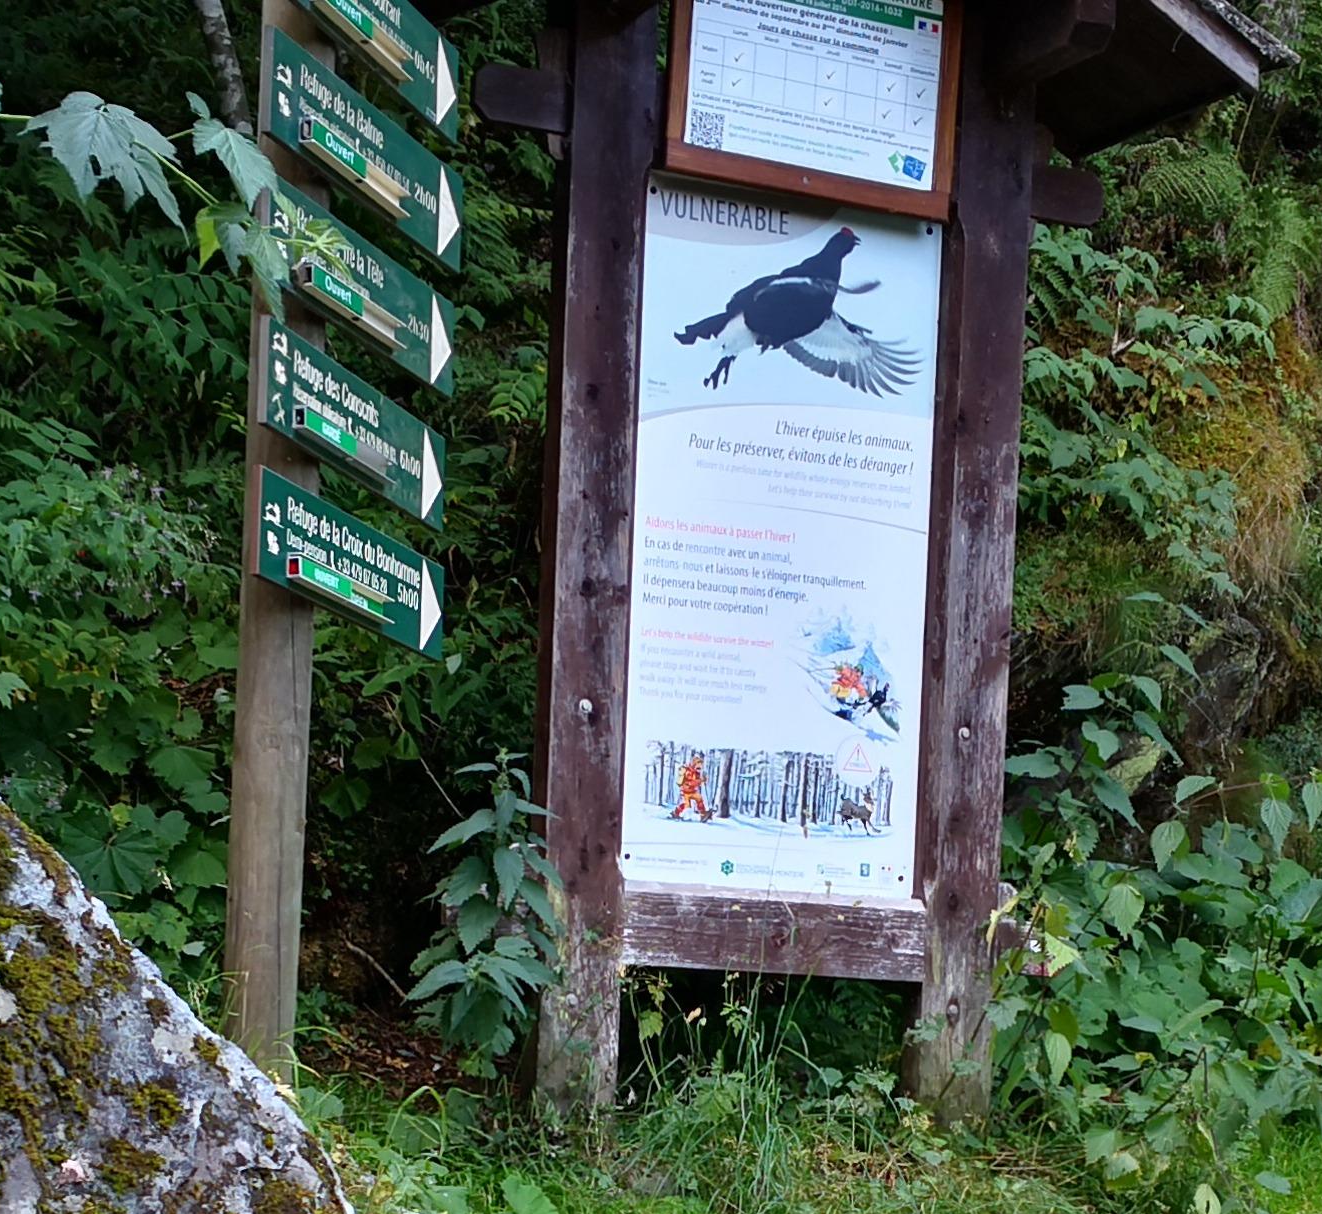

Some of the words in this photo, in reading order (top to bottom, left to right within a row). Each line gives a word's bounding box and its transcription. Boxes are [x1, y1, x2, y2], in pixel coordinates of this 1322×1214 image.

[799, 8, 836, 23] générale
[838, 16, 849, 26] de
[851, 18, 859, 28] la
[860, 21, 888, 34] chasse
[325, 133, 354, 164] Ouvert
[414, 182, 437, 214] 2h00
[660, 190, 790, 235] VULNERABLE
[324, 275, 352, 305] Ouvert
[407, 313, 429, 343] 2h30
[775, 420, 810, 438] L'hiver
[812, 425, 847, 443] épuise
[848, 429, 862, 445] les
[864, 434, 914, 452] animaux.
[399, 449, 421, 479] 6h00
[688, 433, 715, 450] Pour
[716, 436, 732, 452] les
[733, 440, 785, 460] préserver,
[787, 446, 826, 464] évitons
[828, 452, 842, 467] de
[843, 452, 857, 470] les
[860, 455, 908, 478] déranger
[287, 495, 318, 537] Refuge
[319, 516, 331, 541] de
[332, 520, 341, 547] la
[341, 525, 363, 559] Croix
[364, 539, 375, 565] du
[376, 545, 420, 589] Bonhomme
[644, 535, 655, 548] En
[657, 539, 671, 550] cas
[672, 539, 684, 551] de
[397, 583, 419, 611] 5h00
[642, 592, 666, 605] Merci
[668, 597, 688, 609] pour
[690, 599, 712, 610] votre
